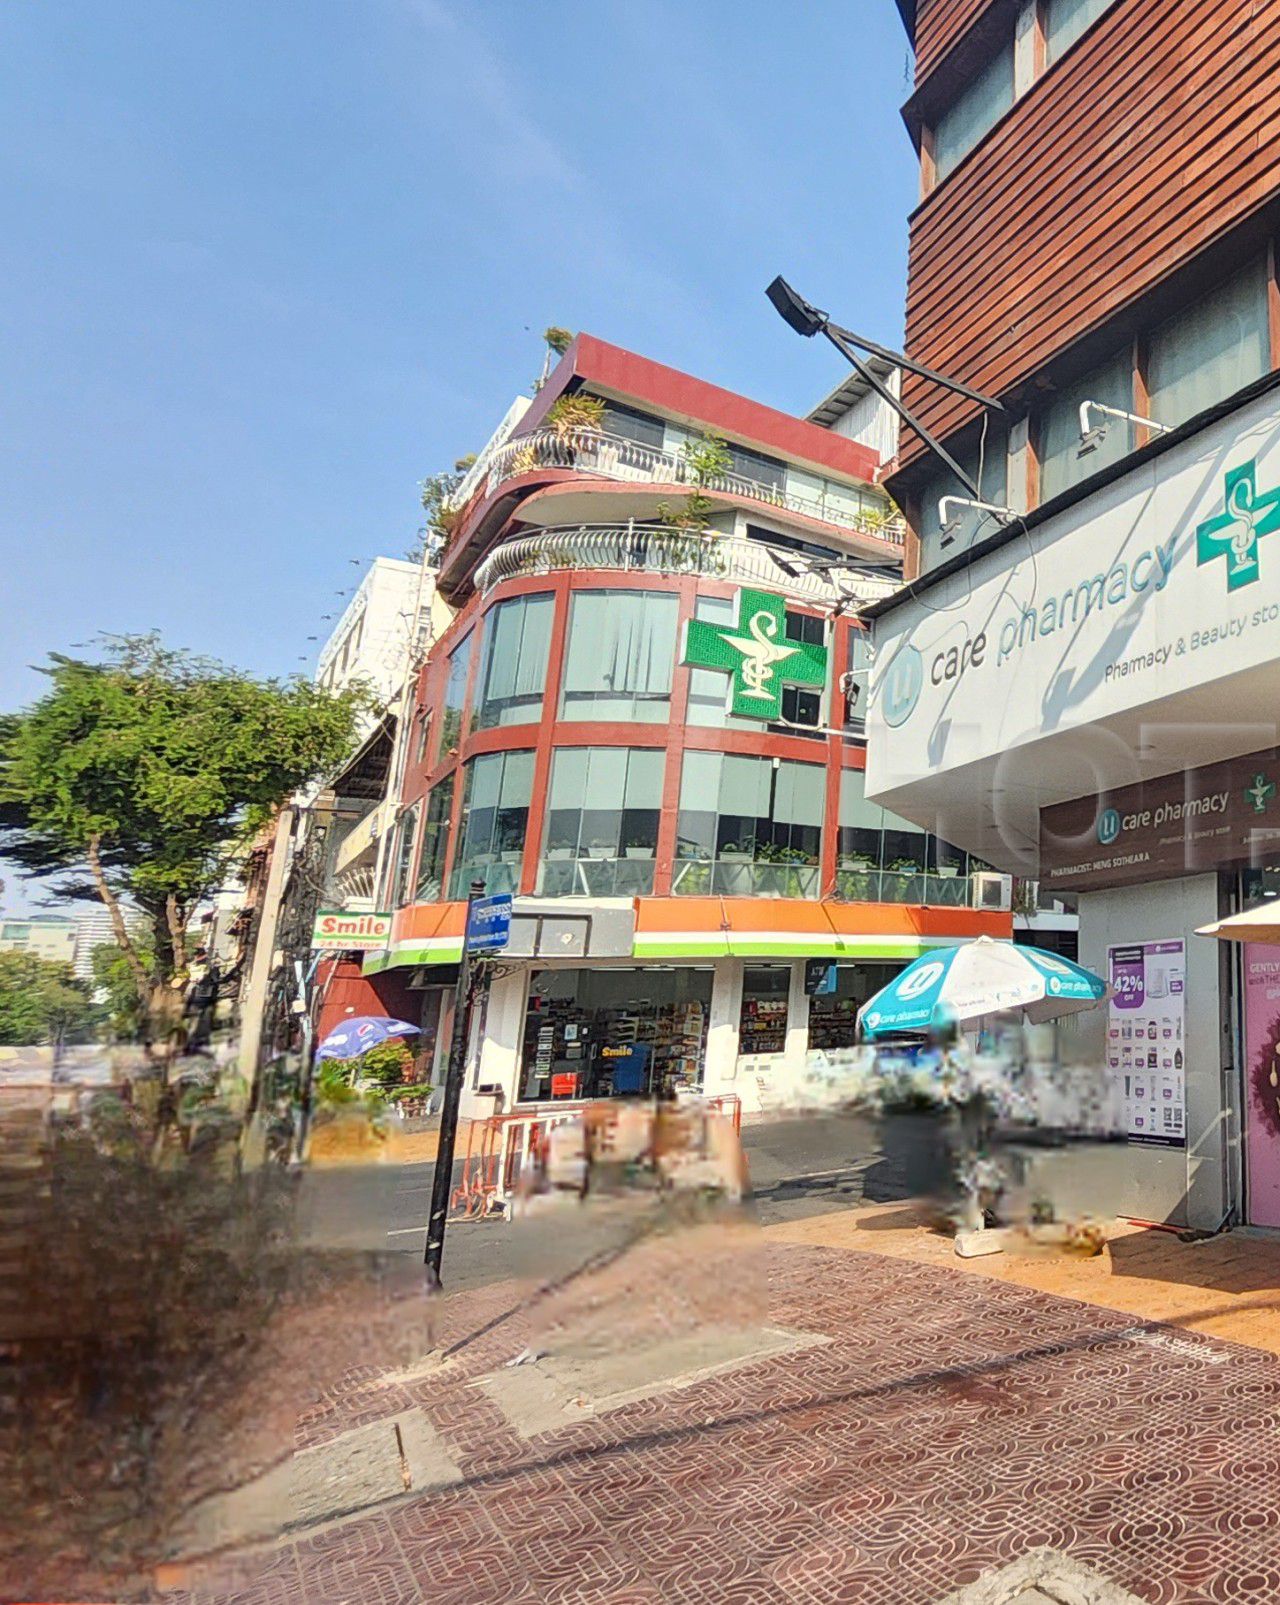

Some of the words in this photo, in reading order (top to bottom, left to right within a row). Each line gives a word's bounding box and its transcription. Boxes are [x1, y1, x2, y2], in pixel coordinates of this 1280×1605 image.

[930, 632, 986, 686] care
[996, 537, 1177, 667] pharmacy
[1104, 643, 1172, 683] Pharmacy
[1175, 637, 1186, 657] &
[1190, 615, 1247, 651] Beauty
[1122, 809, 1151, 831] care
[1153, 791, 1230, 829] pharmacy
[321, 916, 385, 935] Smile
[1249, 962, 1280, 973] GENTLY
[1113, 975, 1144, 992] 42%
[602, 1045, 633, 1057] Smile
